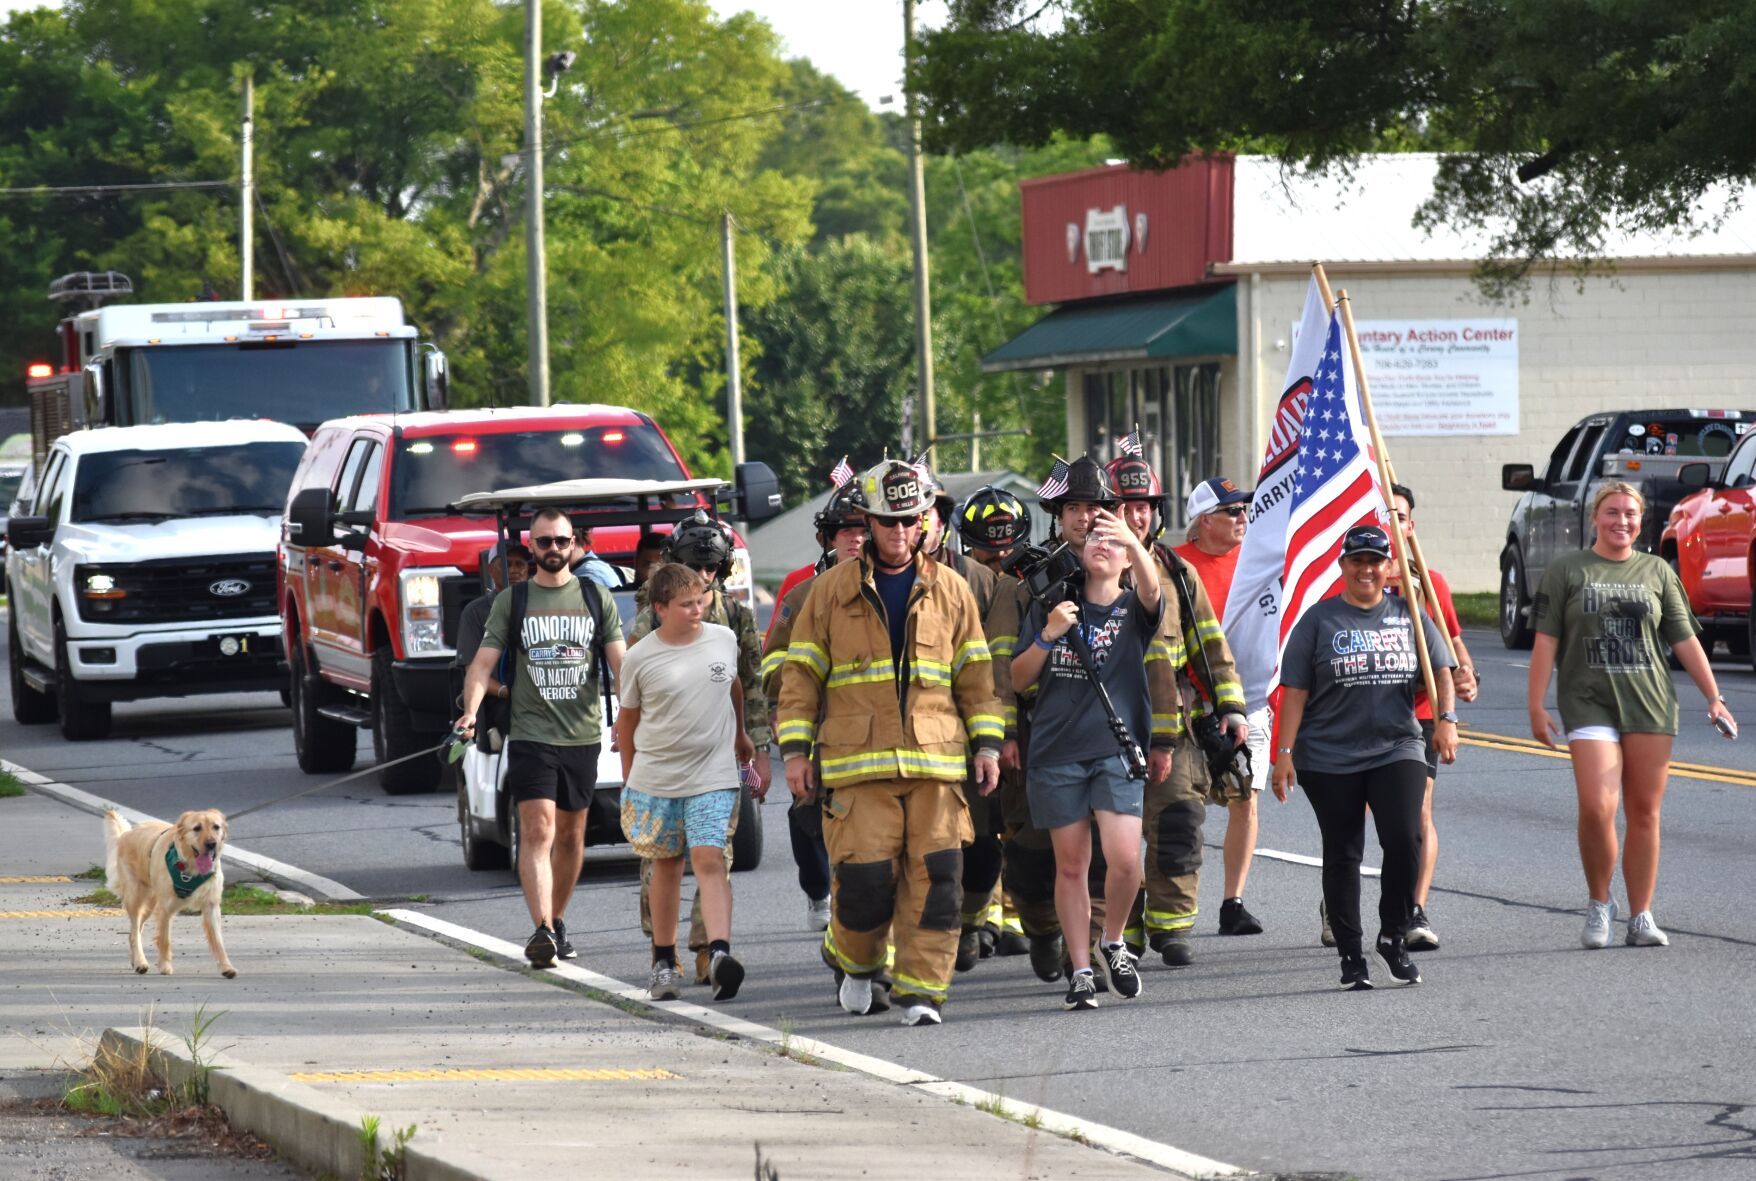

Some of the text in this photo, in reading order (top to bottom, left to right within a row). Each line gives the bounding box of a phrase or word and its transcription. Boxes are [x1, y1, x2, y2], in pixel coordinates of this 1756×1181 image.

[1357, 327, 1514, 345] untary Action Center
[1121, 473, 1148, 486] 955
[886, 481, 918, 501] 902
[988, 524, 1013, 538] 976
[217, 582, 241, 594] Ford
[521, 615, 595, 650] HONORING
[1332, 627, 1411, 655] CARRY
[240, 637, 249, 653] 1
[531, 650, 552, 658] CARRY
[1331, 652, 1418, 677] THE LOAD
[527, 663, 589, 687] OUR NATION'S
[540, 687, 577, 700] HEROES
